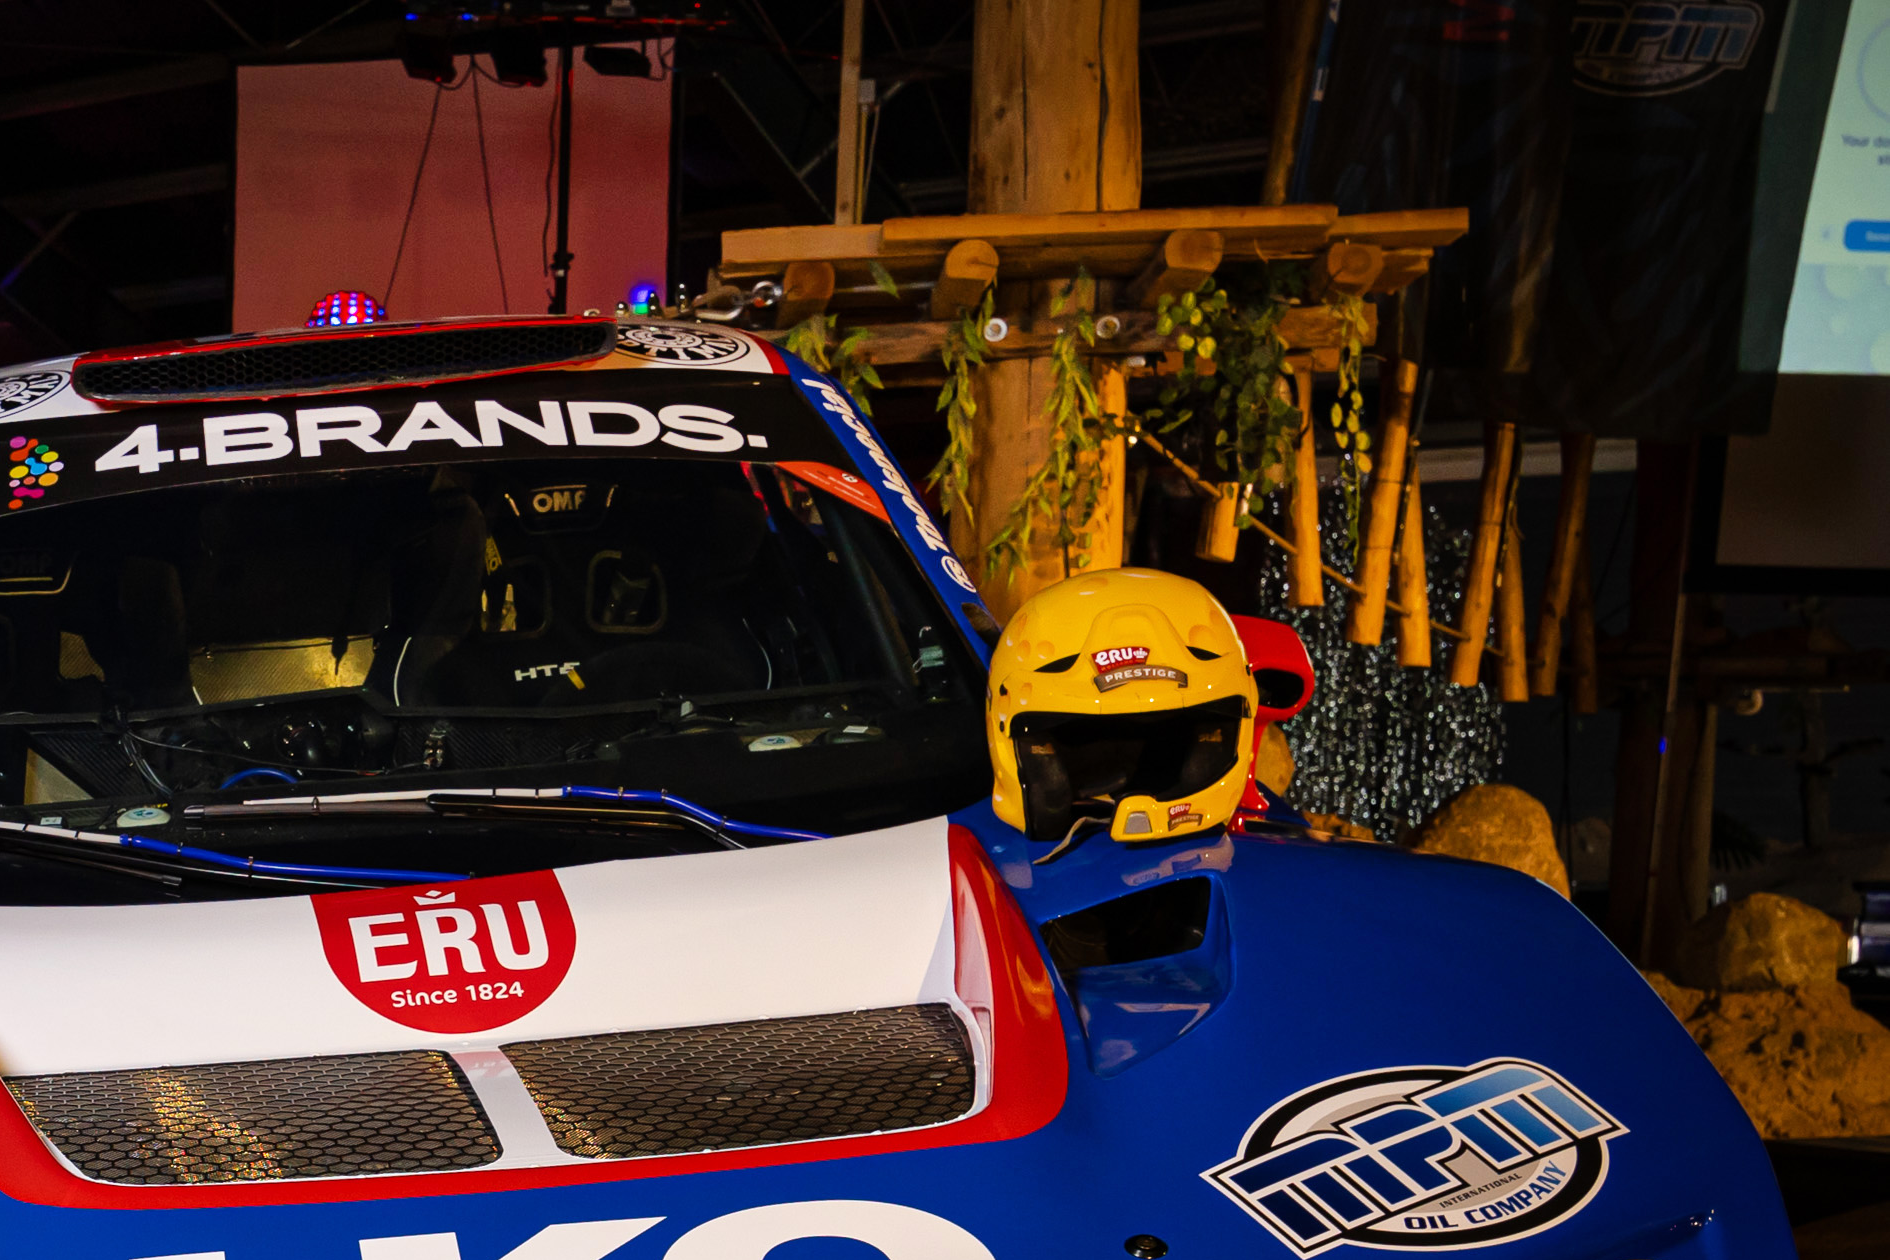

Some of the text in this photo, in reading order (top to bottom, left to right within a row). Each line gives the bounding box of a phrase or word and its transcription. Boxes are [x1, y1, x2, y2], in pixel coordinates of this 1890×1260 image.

[1105, 668, 1177, 683] PRESTIGE
[391, 981, 524, 1008] Since 1824
[1404, 1160, 1567, 1230] OIL COMPANY
[1439, 1172, 1523, 1209] INTERNATIONAL
